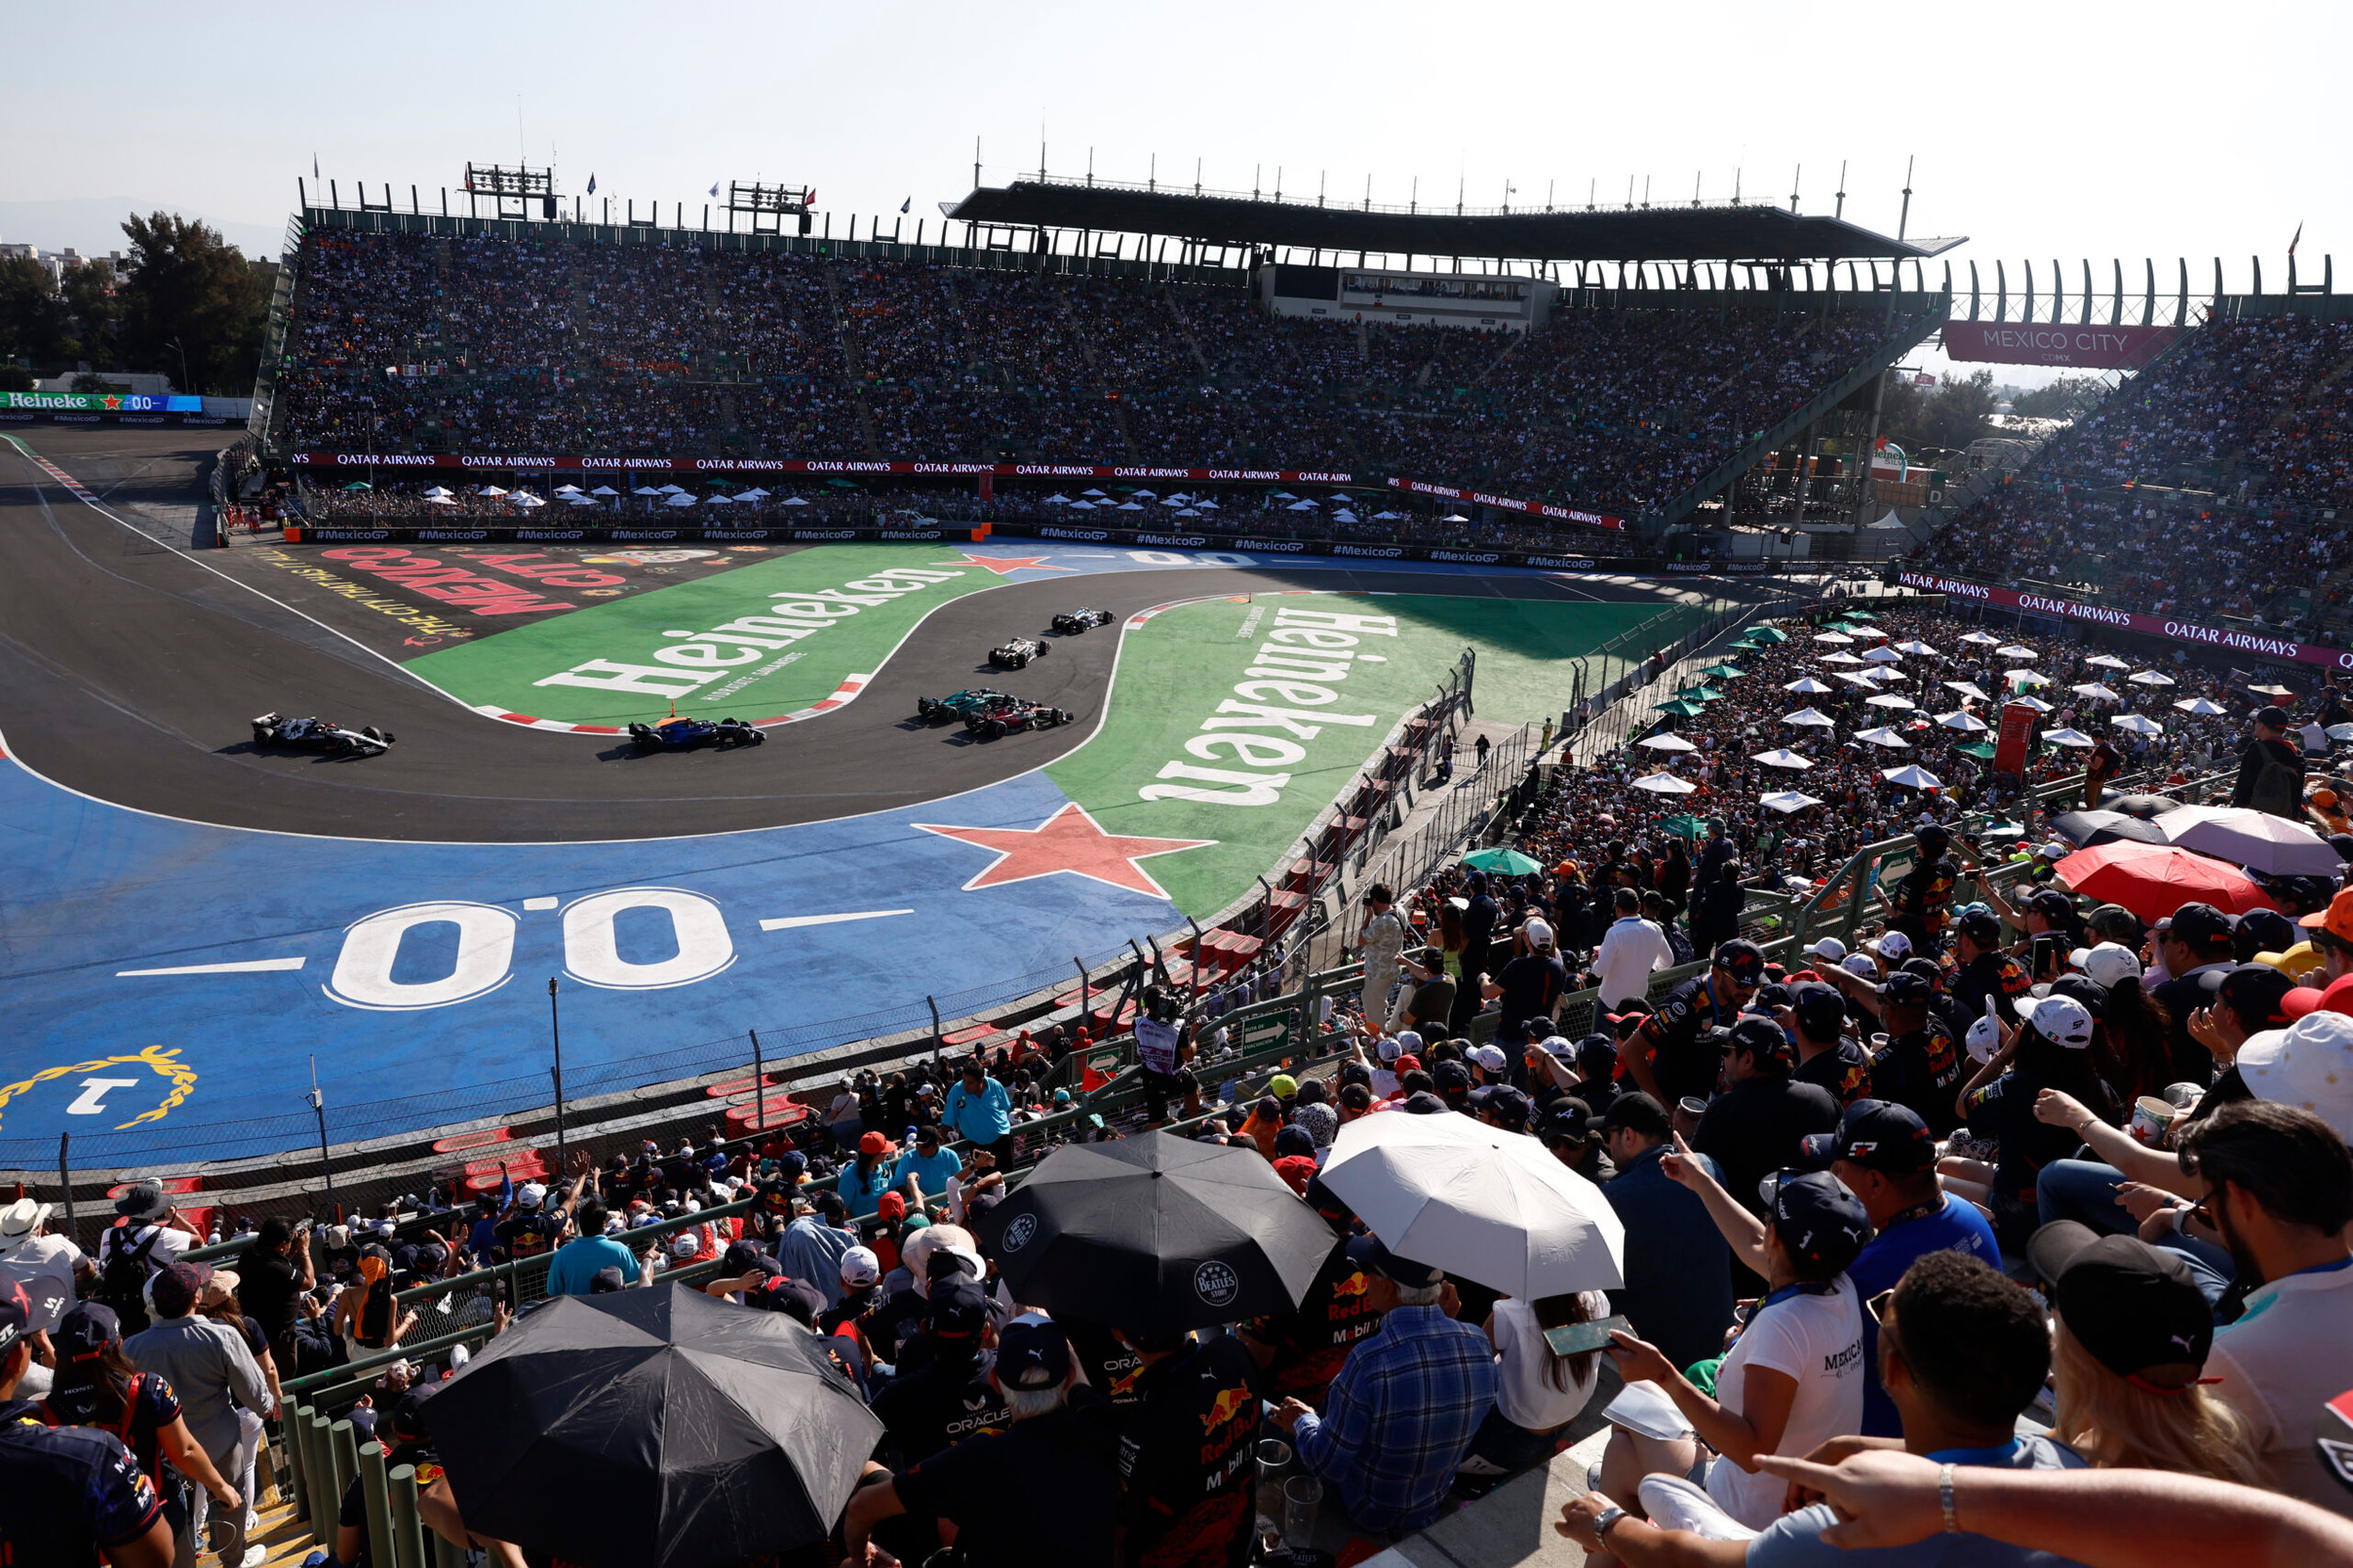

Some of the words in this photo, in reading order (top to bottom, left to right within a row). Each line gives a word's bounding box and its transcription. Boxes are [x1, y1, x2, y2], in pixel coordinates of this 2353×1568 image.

[1984, 330, 2067, 349] MEXICO
[2075, 333, 2128, 352] CITY
[2041, 354, 2071, 362] CDMX
[337, 455, 378, 465] QATAR
[383, 455, 435, 465] AIRWAYS
[461, 456, 502, 467] QATAR
[505, 456, 555, 467] AIRWAYS
[582, 457, 621, 468] QATAR
[625, 457, 672, 469] AIRWAYS
[696, 459, 734, 470] QATAR
[738, 459, 783, 471] AIRWAYS
[807, 461, 843, 471] QATAR
[847, 461, 890, 472] AIRWAYS
[914, 462, 949, 472] QATAR
[1016, 465, 1052, 474] QATAR
[1053, 466, 1094, 476] AIRWAYS
[1114, 467, 1146, 477] QATAR
[1148, 468, 1188, 478] AIRWAYS
[1209, 470, 1241, 480] QATAR
[1242, 471, 1280, 480] AIRWAYS
[1299, 472, 1330, 482] QATAR
[1412, 482, 1433, 493] QATAR
[1433, 486, 1459, 498] AIRWAYS
[1473, 492, 1497, 505] QATAR
[1497, 497, 1527, 510] AIRWAYS
[1542, 504, 1568, 518] QATAR
[1568, 510, 1602, 525] AIRWAYS
[316, 530, 388, 540] #MexicoGP
[419, 530, 488, 540] #MexicoGP
[518, 530, 584, 540] #MexicoGP
[612, 530, 677, 540] #MexicoGP
[704, 530, 768, 540] #MexicoGP
[794, 530, 856, 540] #MexicoGP
[881, 530, 941, 540] #MexicoGP
[1041, 527, 1107, 540] #MexicoGP
[1137, 534, 1206, 547] #MexicoGP
[1235, 539, 1305, 552] #MexicoGP
[1334, 545, 1402, 558] #MexicoGP
[1431, 550, 1498, 563] #MexicoGP
[1527, 555, 1594, 569] #MexicoGP
[1666, 563, 1711, 572] #MexicoGP
[290, 568, 343, 582] HAS
[456, 553, 626, 587] CITY
[321, 548, 578, 616] MEXICO
[1937, 578, 1990, 599] AIRWAYS
[316, 582, 380, 599] THAT
[357, 599, 420, 616] CITY
[2019, 594, 2065, 614] QATAR
[2068, 603, 2131, 626] AIRWAYS
[397, 616, 461, 635] THE
[532, 567, 967, 699] Heineken
[2165, 621, 2219, 643] QATAR
[2223, 632, 2297, 657] AIRWAYS
[1138, 607, 1399, 807] Heineken
[1210, 1288, 1227, 1298] STORY
[1328, 1297, 1360, 1321] Red
[1333, 1320, 1370, 1344] Mobil
[1824, 1337, 1862, 1371] MEXICA
[1103, 1355, 1143, 1370] ORA
[64, 1384, 94, 1395] HOND
[947, 1406, 1011, 1434] ORACLE
[1201, 1423, 1233, 1465] Red
[1207, 1449, 1242, 1491] Mobil
